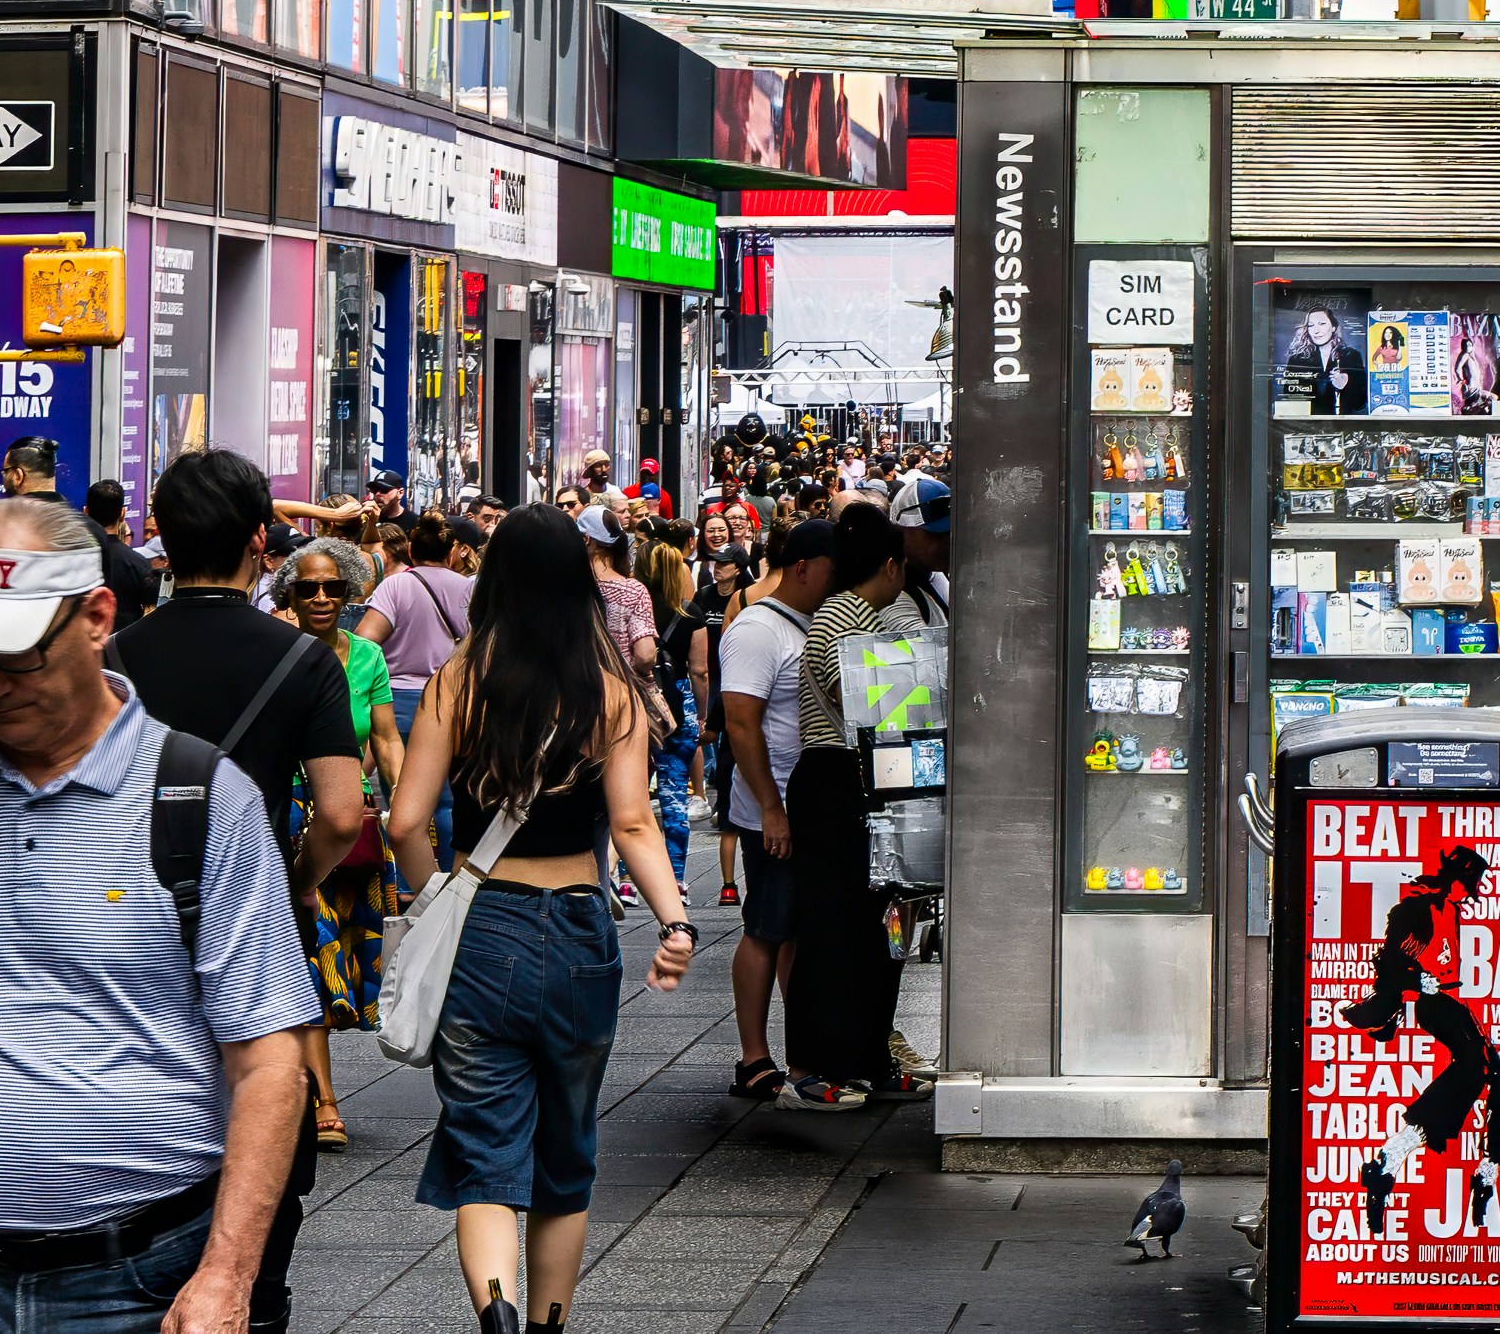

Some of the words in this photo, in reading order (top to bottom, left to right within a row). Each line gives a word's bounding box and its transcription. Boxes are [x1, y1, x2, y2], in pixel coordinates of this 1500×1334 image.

[993, 133, 1034, 384] Newsstand
[1120, 275, 1161, 293] SIM
[1106, 307, 1175, 326] CARD
[1313, 806, 1427, 856] BEAT
[1313, 861, 1423, 939] IT
[1312, 943, 1341, 960] MAN
[1344, 944, 1357, 960] IN
[1311, 984, 1347, 999] BLAME
[1311, 1036, 1435, 1062] BILLIE
[1308, 1065, 1433, 1097] JEAN
[1307, 1193, 1351, 1207] THEY
[1306, 1245, 1377, 1262] ABOUT
[1381, 1244, 1409, 1262] US
[1418, 1246, 1445, 1262] DON'T
[1446, 1246, 1469, 1262] STOP
